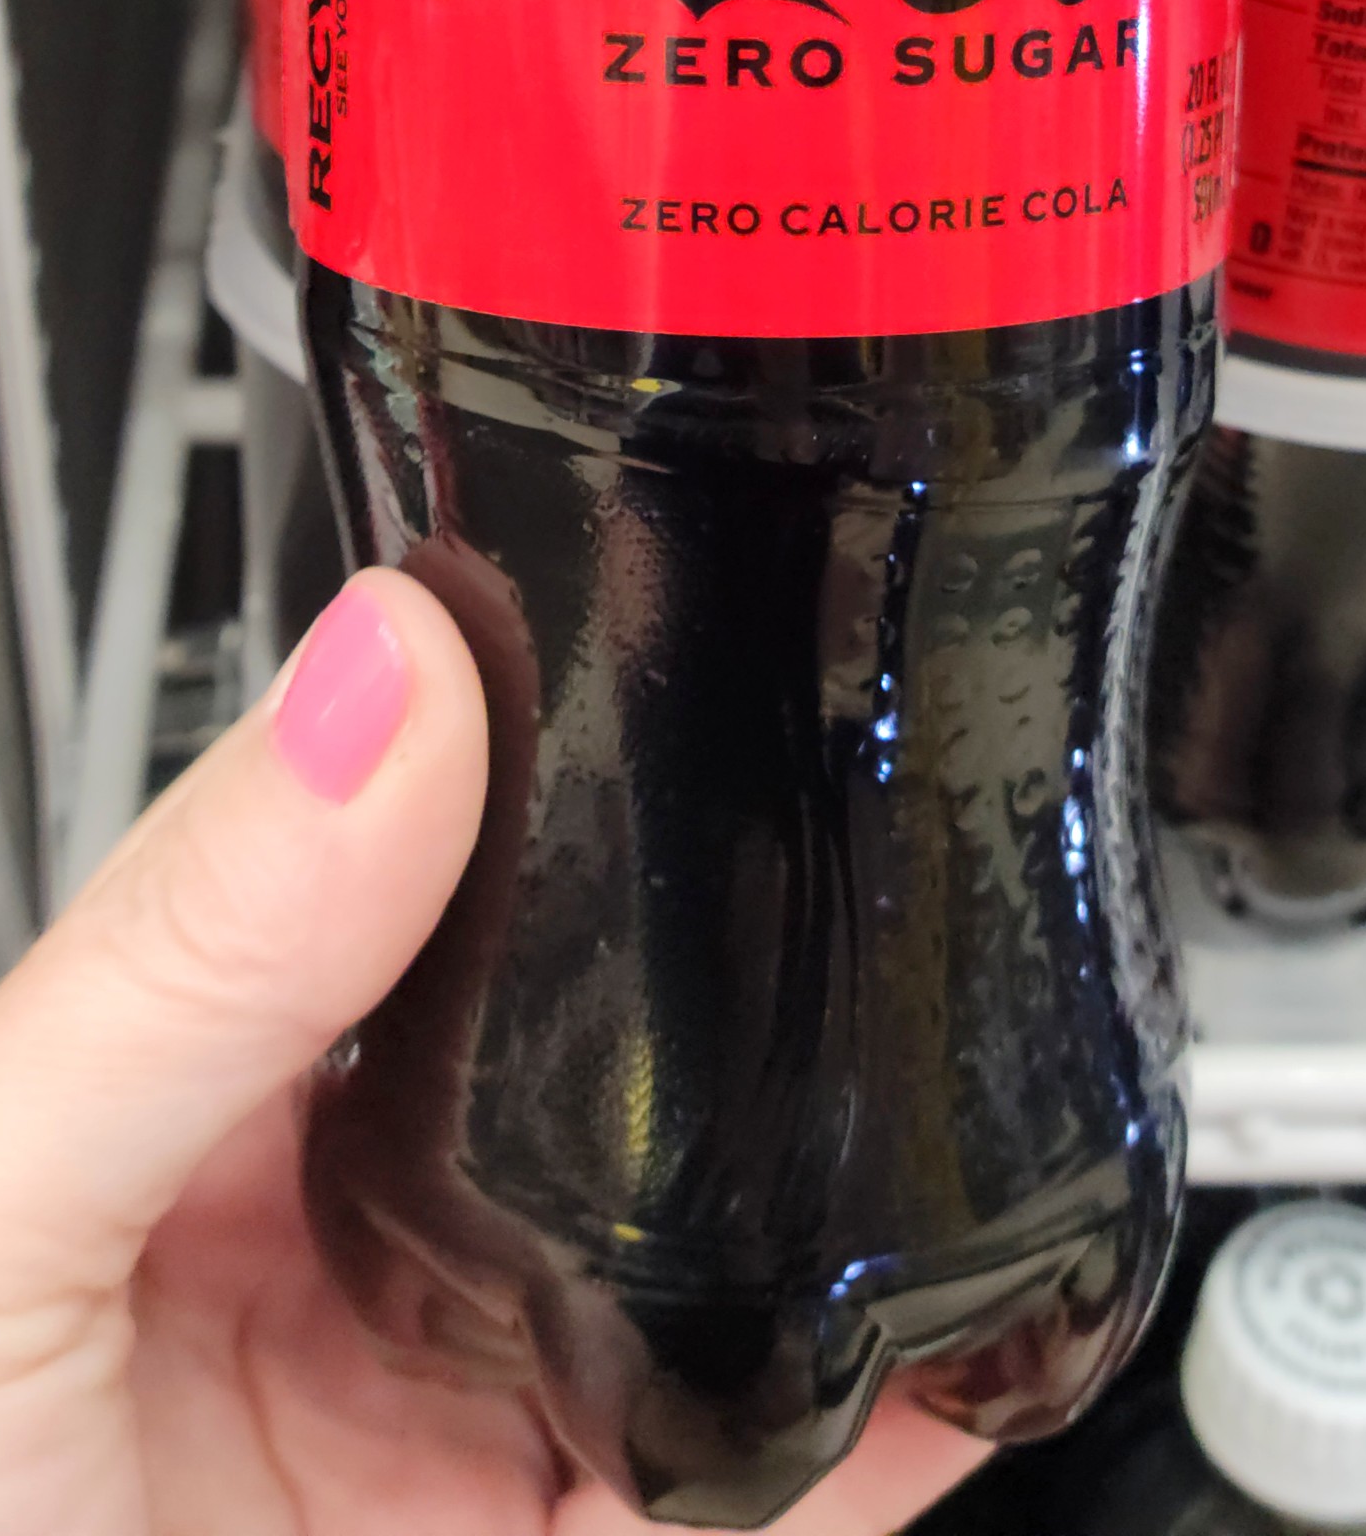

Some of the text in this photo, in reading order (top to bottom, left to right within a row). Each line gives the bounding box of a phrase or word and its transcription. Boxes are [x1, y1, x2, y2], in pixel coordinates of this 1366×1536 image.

[334, 50, 349, 119] SEE
[602, 18, 1142, 89] ZERO SUGAR
[619, 177, 1129, 237] ZERO CALORIE COLA
